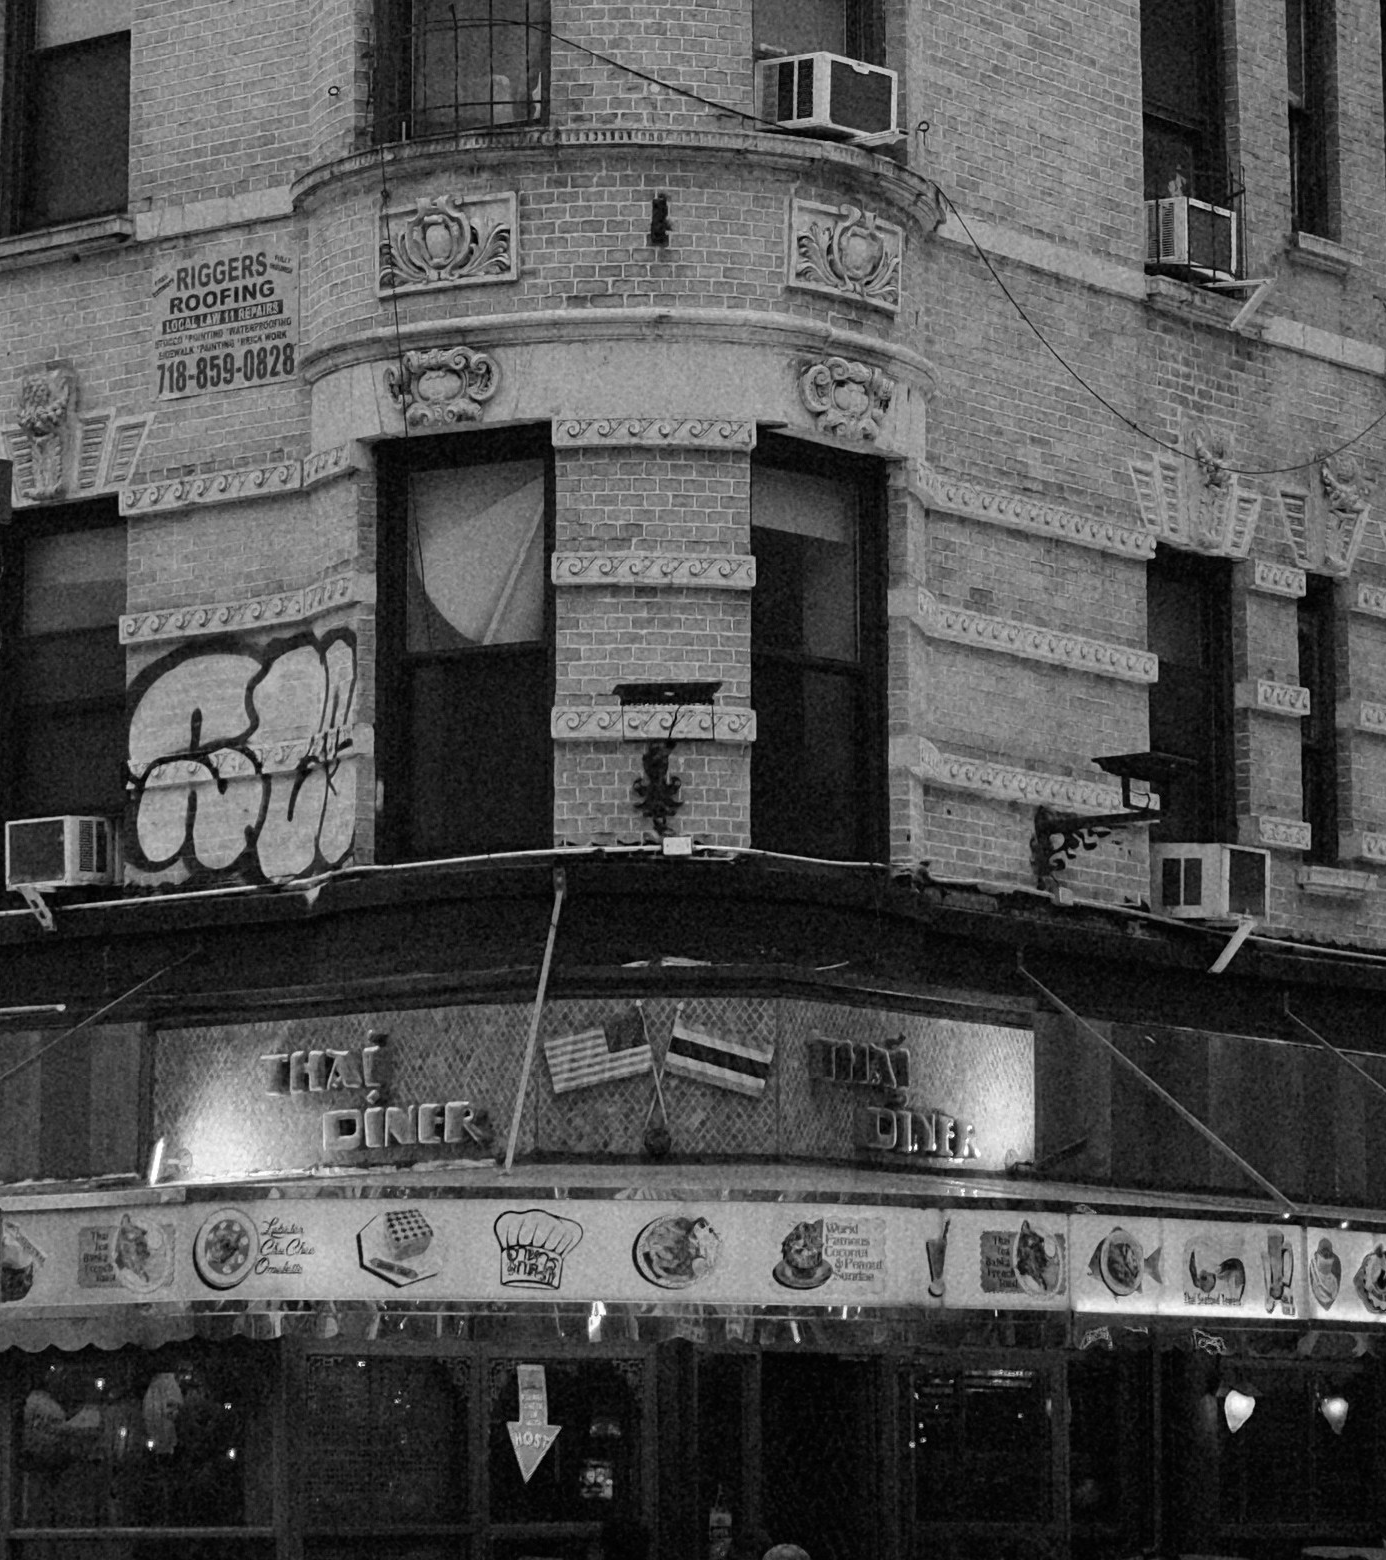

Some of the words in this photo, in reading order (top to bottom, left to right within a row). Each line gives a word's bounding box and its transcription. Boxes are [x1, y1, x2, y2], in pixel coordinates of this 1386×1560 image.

[176, 251, 267, 292] RIGGERS
[165, 316, 198, 334] LOCAL
[200, 312, 221, 329] LAW
[224, 310, 235, 323] 11
[238, 301, 280, 321] REPAIRS
[169, 279, 275, 315] ROOFING
[265, 329, 288, 341] WORK
[156, 342, 295, 395] 718-859-0828
[322, 1092, 482, 1152] DINER
[857, 1100, 981, 1159] DINER
